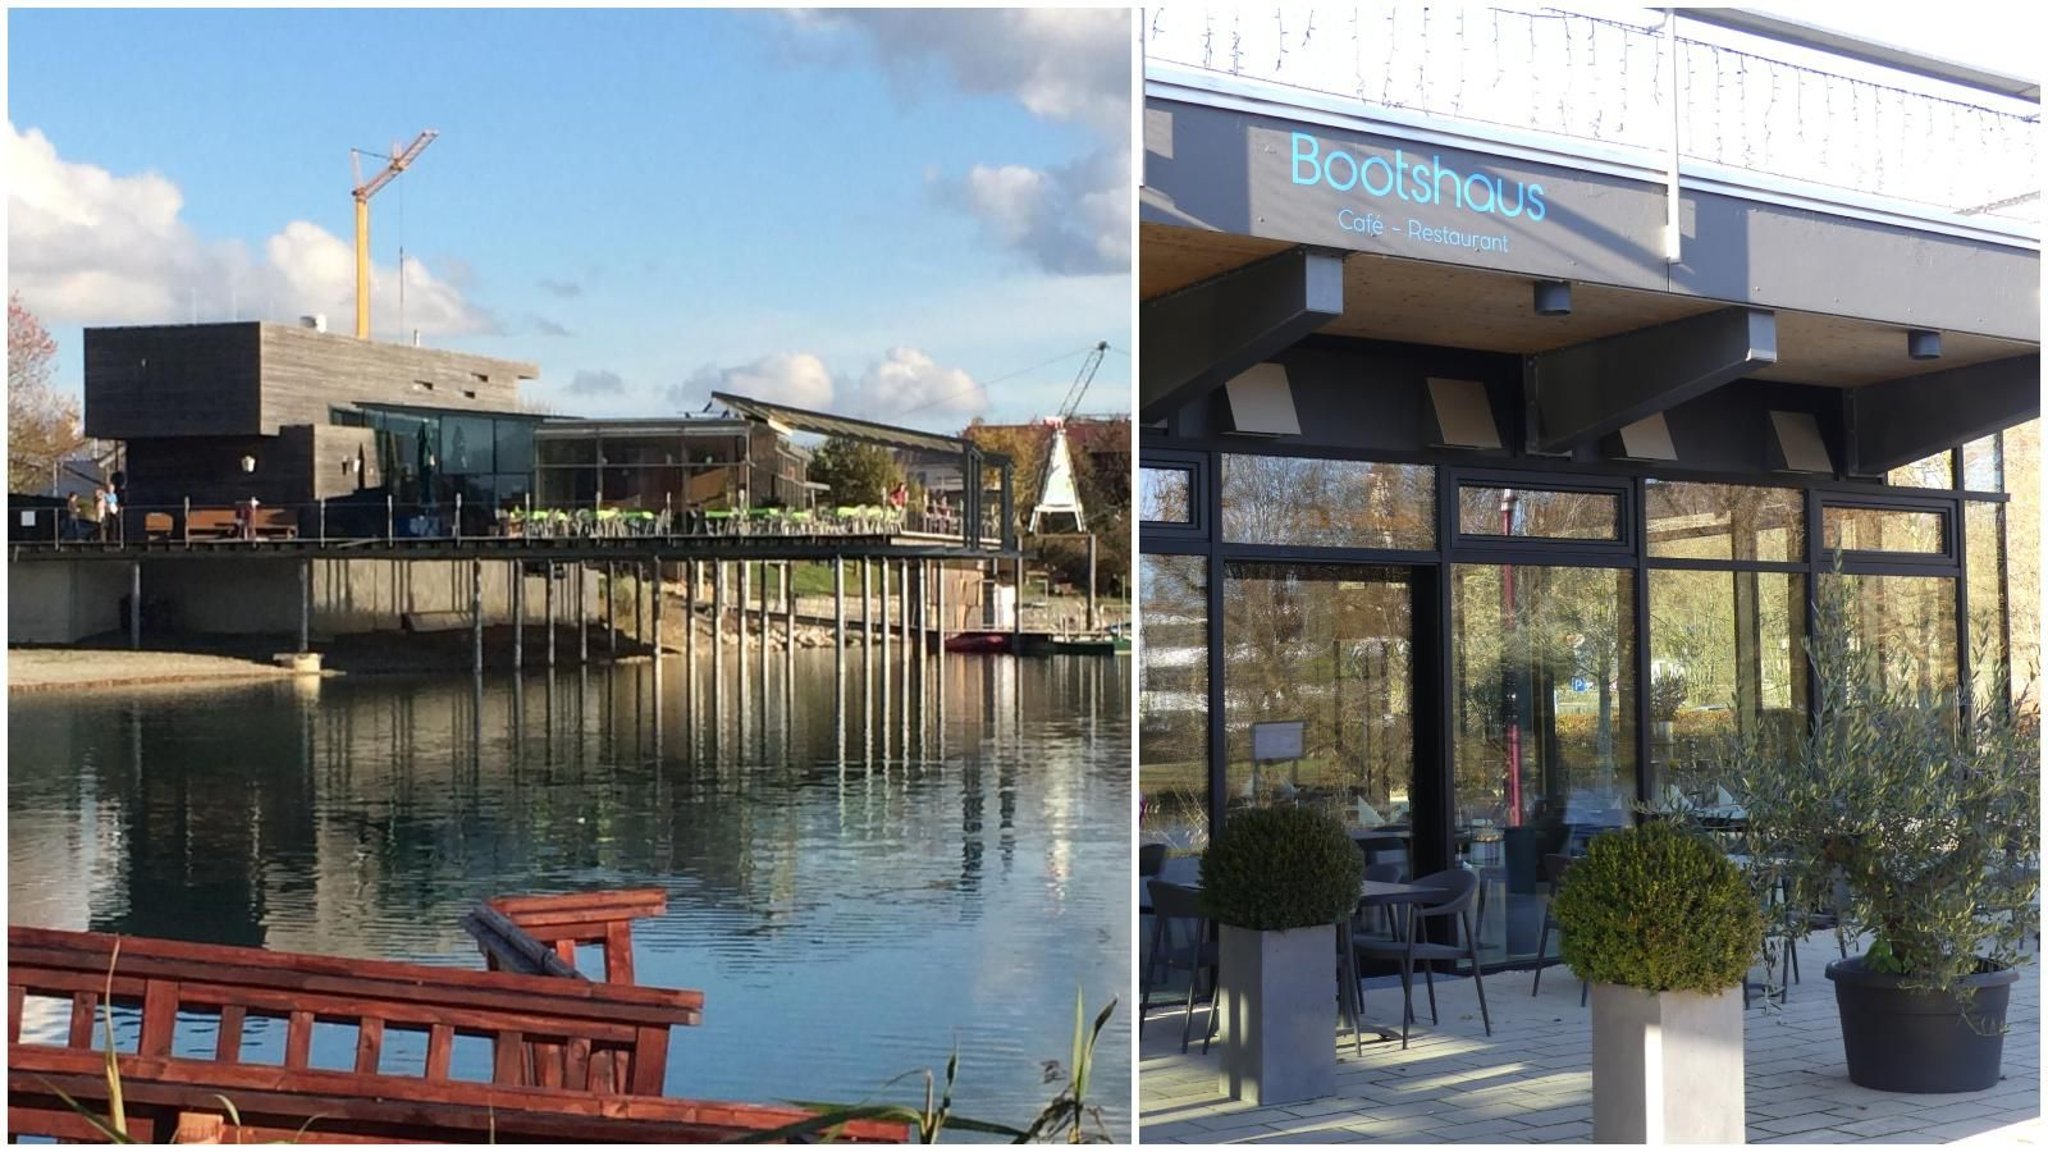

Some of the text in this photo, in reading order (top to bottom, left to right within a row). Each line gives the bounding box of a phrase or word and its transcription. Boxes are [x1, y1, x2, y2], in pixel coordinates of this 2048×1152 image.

[1291, 132, 1546, 221] Bootshaus
[1338, 209, 1384, 235] Café
[1408, 219, 1508, 253] Restaurant
